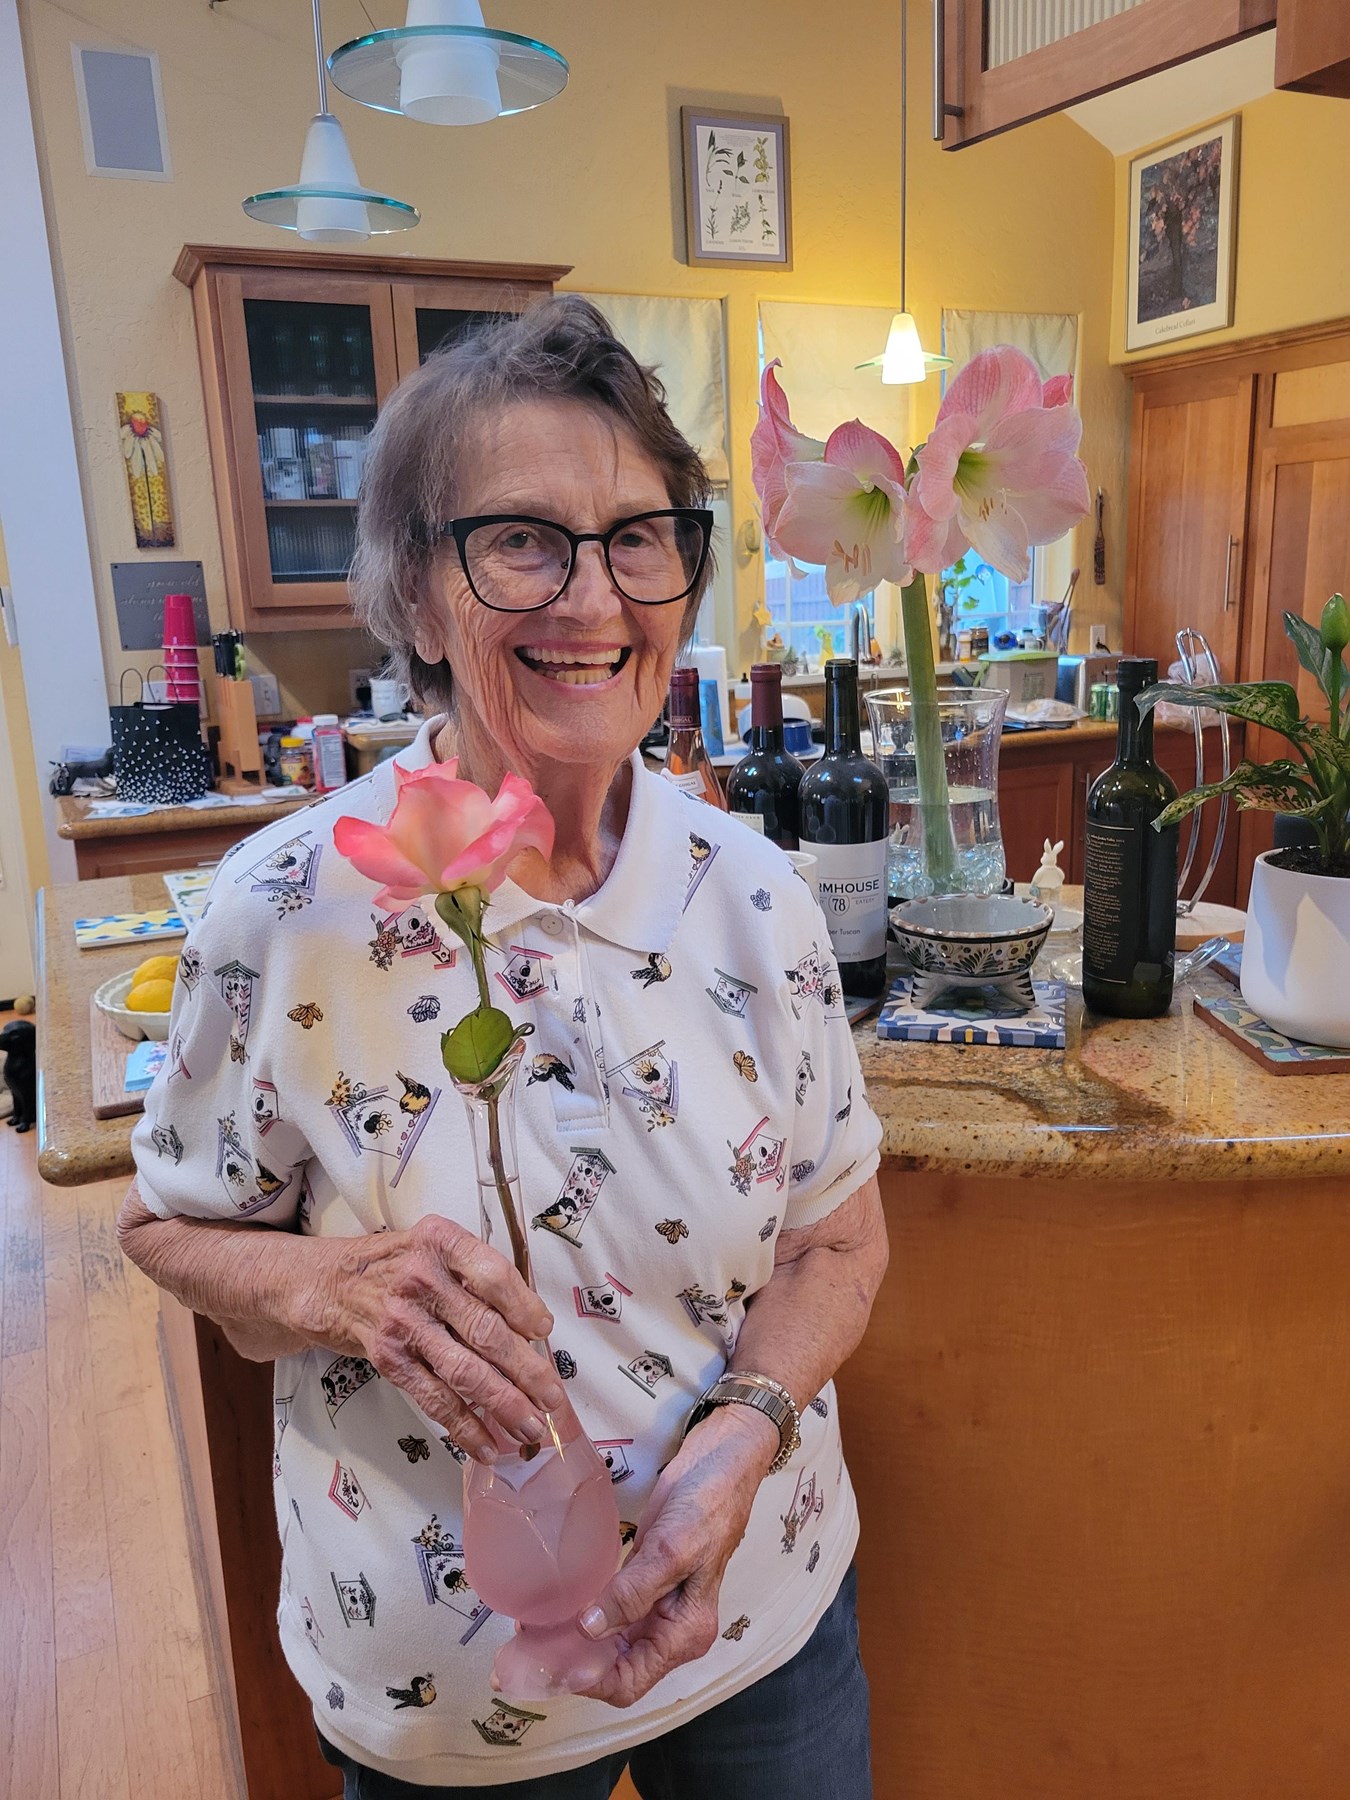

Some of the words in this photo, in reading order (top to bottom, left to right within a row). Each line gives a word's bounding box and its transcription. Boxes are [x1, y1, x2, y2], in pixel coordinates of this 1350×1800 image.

[819, 879, 880, 893] RMHOUSE
[832, 898, 846, 911] 78
[839, 928, 861, 936] Tuscan
